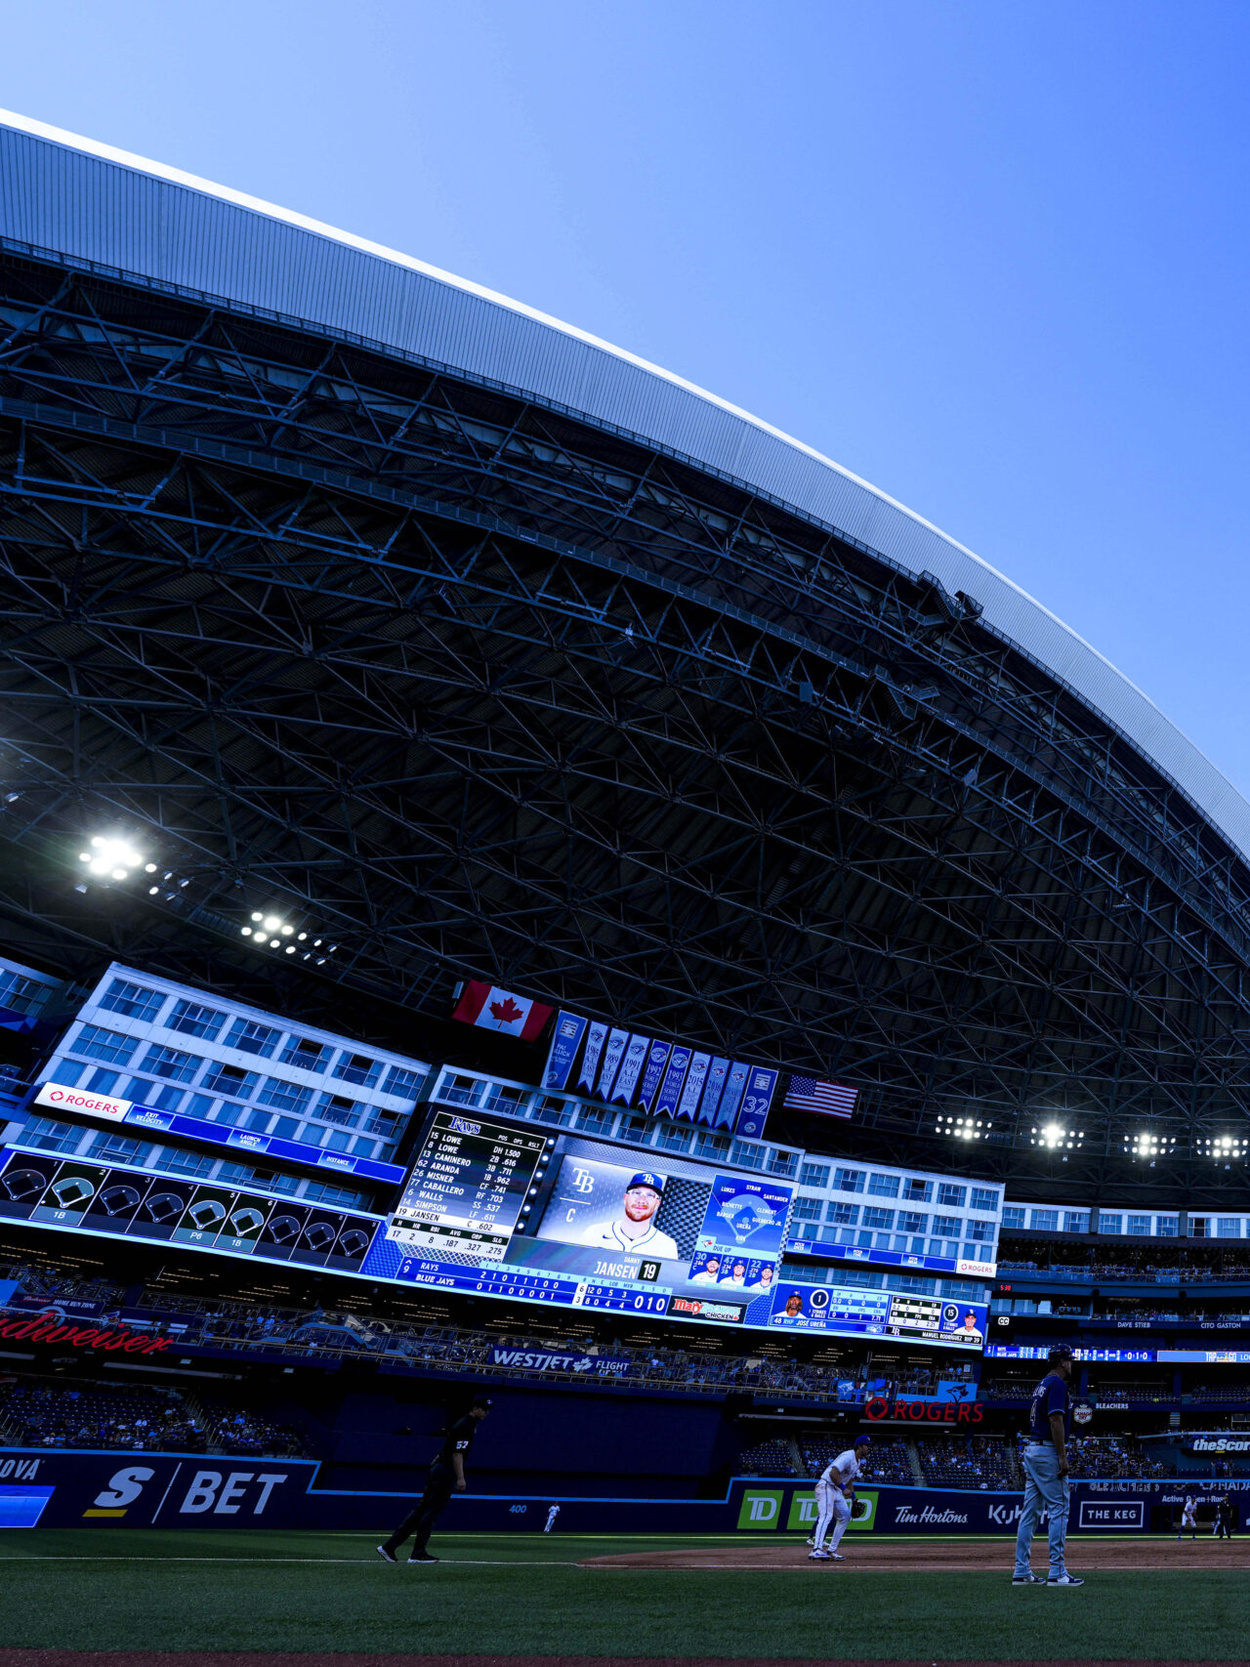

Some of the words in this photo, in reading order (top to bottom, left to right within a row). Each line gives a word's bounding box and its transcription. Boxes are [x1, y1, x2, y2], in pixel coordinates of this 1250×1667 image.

[626, 1059, 640, 1070] 1991
[66, 1094, 120, 1114] ROGERS
[743, 1095, 769, 1116] 32
[136, 1114, 164, 1125] VELOCITY
[448, 1116, 481, 1136] RAYS
[430, 1132, 439, 1140] 15
[442, 1134, 463, 1145] LOWE
[493, 1146, 502, 1155] DH
[504, 1149, 521, 1159] 1.500
[326, 1156, 350, 1166] DISTANCE
[438, 1143, 459, 1154] LOWE
[490, 1155, 500, 1164] 2B
[501, 1158, 516, 1167] .616
[422, 1150, 431, 1158] 13
[435, 1153, 471, 1167] CAMINERO
[486, 1164, 496, 1173] 3B
[499, 1167, 512, 1176] .711
[417, 1159, 427, 1168] 62
[430, 1162, 460, 1175] ARANDA
[484, 1173, 492, 1181] 1B
[494, 1176, 510, 1186] .962
[642, 1173, 654, 1185] TB
[413, 1169, 424, 1178] 26
[426, 1171, 454, 1184] MISNER
[479, 1183, 489, 1191] CF
[491, 1185, 506, 1195] .741
[572, 1167, 595, 1193] TB
[410, 1178, 420, 1187] 77
[422, 1181, 464, 1196] CABALLERO
[475, 1192, 486, 1200] RF
[487, 1194, 504, 1203] .703
[414, 1200, 448, 1213] SIMPSON
[419, 1190, 444, 1202] WALLS
[472, 1201, 482, 1209] SS
[483, 1203, 501, 1213] .537
[53, 1210, 67, 1220] 1B
[398, 1207, 407, 1216] 19
[410, 1209, 441, 1222] JANSEN
[476, 1222, 493, 1232] .602
[566, 1209, 576, 1223] C
[190, 1231, 203, 1241] P6
[450, 1229, 462, 1238] AVG
[231, 1238, 242, 1247] 1B
[392, 1231, 401, 1239] 17
[443, 1239, 459, 1248] .187
[464, 1243, 481, 1252] .327
[486, 1246, 502, 1255] .275
[695, 1251, 707, 1260] 30
[722, 1256, 735, 1265] 47
[593, 1261, 639, 1280] JANSEN
[643, 1264, 657, 1280] 19
[750, 1260, 762, 1268] 22
[968, 1264, 993, 1274] ROGERS
[415, 1273, 436, 1284] BLUE
[436, 1276, 455, 1286] JAYS
[420, 1262, 440, 1272] RAYS
[587, 1286, 595, 1295] 12
[634, 1295, 645, 1309] 0
[646, 1297, 654, 1310] 1
[655, 1298, 666, 1312] 0
[672, 1298, 703, 1316] Mary
[704, 1311, 735, 1321] CHICKEN
[947, 1309, 954, 1317] 15
[774, 1316, 782, 1324] 48
[1117, 1321, 1133, 1329] DAVE
[1134, 1321, 1151, 1329] STIEB
[1200, 1322, 1215, 1330] CITO
[1216, 1322, 1242, 1330] GASTON
[973, 1336, 980, 1344] 39
[494, 1350, 574, 1371] WESTJET
[595, 1360, 631, 1371] FLIGHT
[893, 1400, 984, 1423] ROGERS
[1095, 1402, 1129, 1410] BLEACHERS
[456, 1440, 469, 1450] 57
[179, 1470, 289, 1515] BET
[1161, 1495, 1184, 1503] Active
[509, 1504, 527, 1514] 400
[747, 1496, 777, 1521] TD
[894, 1505, 919, 1524] Tim
[919, 1504, 969, 1524] Hortons
[1087, 1509, 1111, 1520] THE
[1113, 1509, 1137, 1520] KEG
